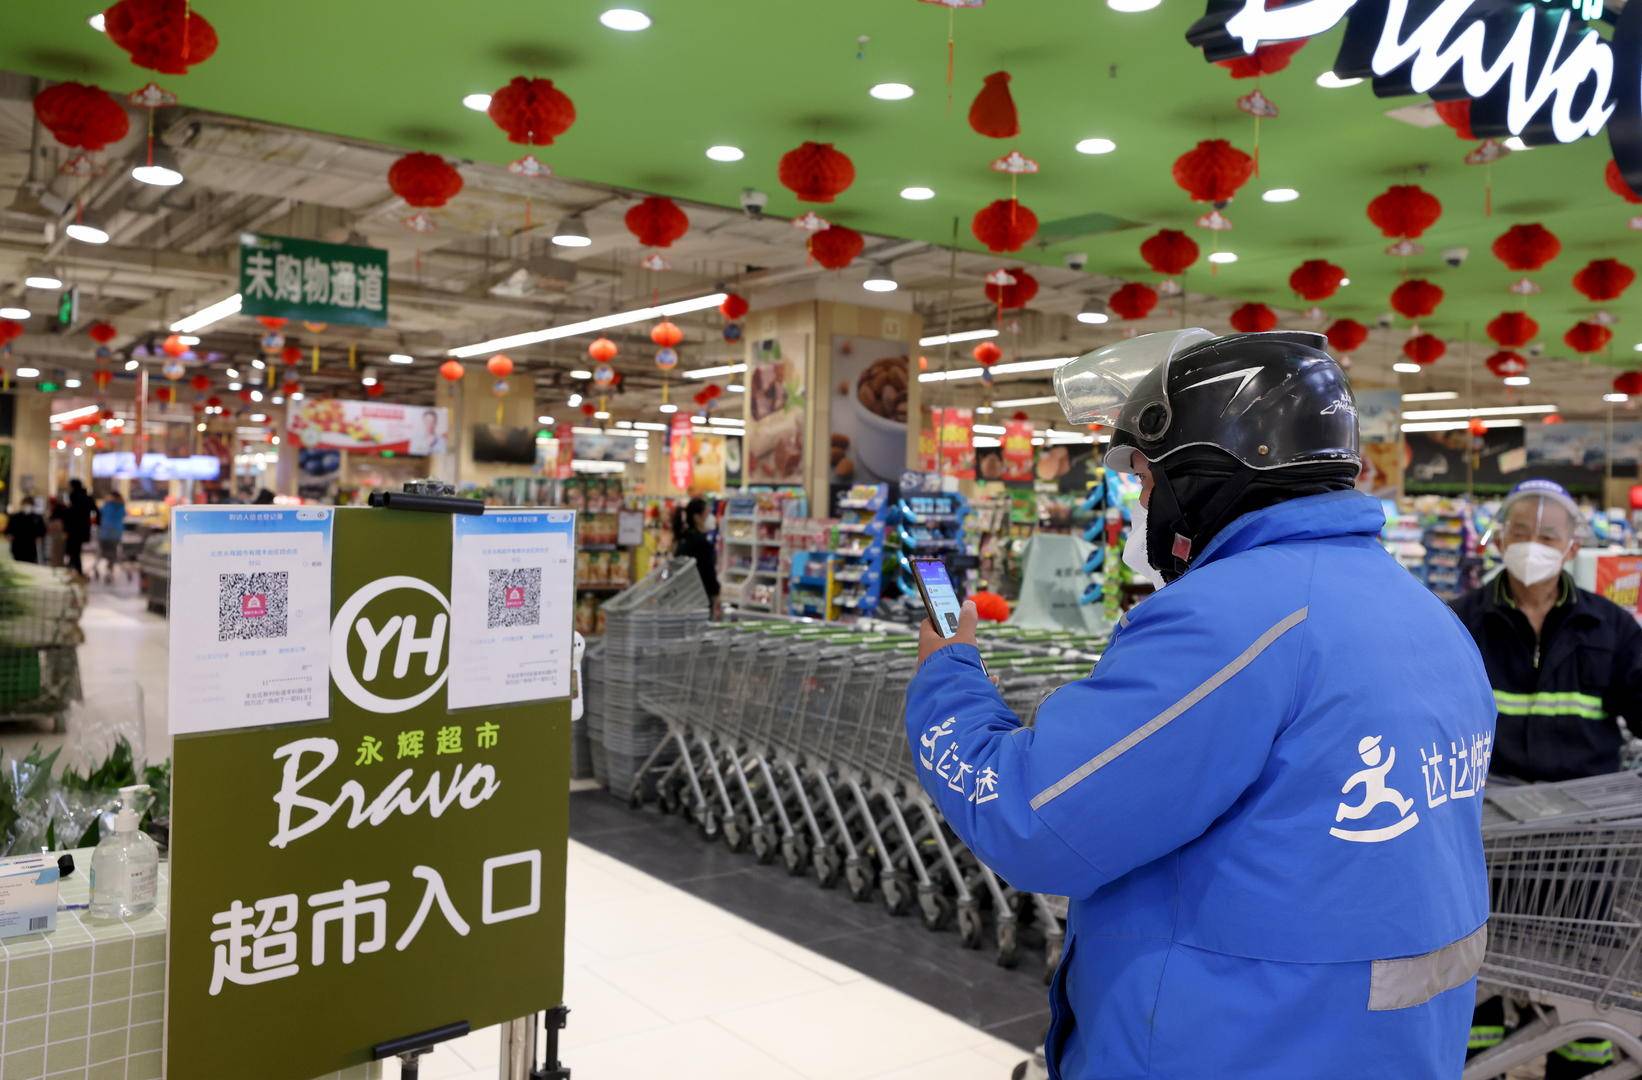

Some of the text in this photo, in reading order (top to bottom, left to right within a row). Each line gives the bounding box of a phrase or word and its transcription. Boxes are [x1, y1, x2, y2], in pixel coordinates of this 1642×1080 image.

[245, 252, 383, 311] 未购物通道
[355, 614, 447, 681] YH
[355, 722, 501, 766] 永辉超市
[269, 736, 501, 850] Bravo
[208, 848, 542, 996] 超市入口
